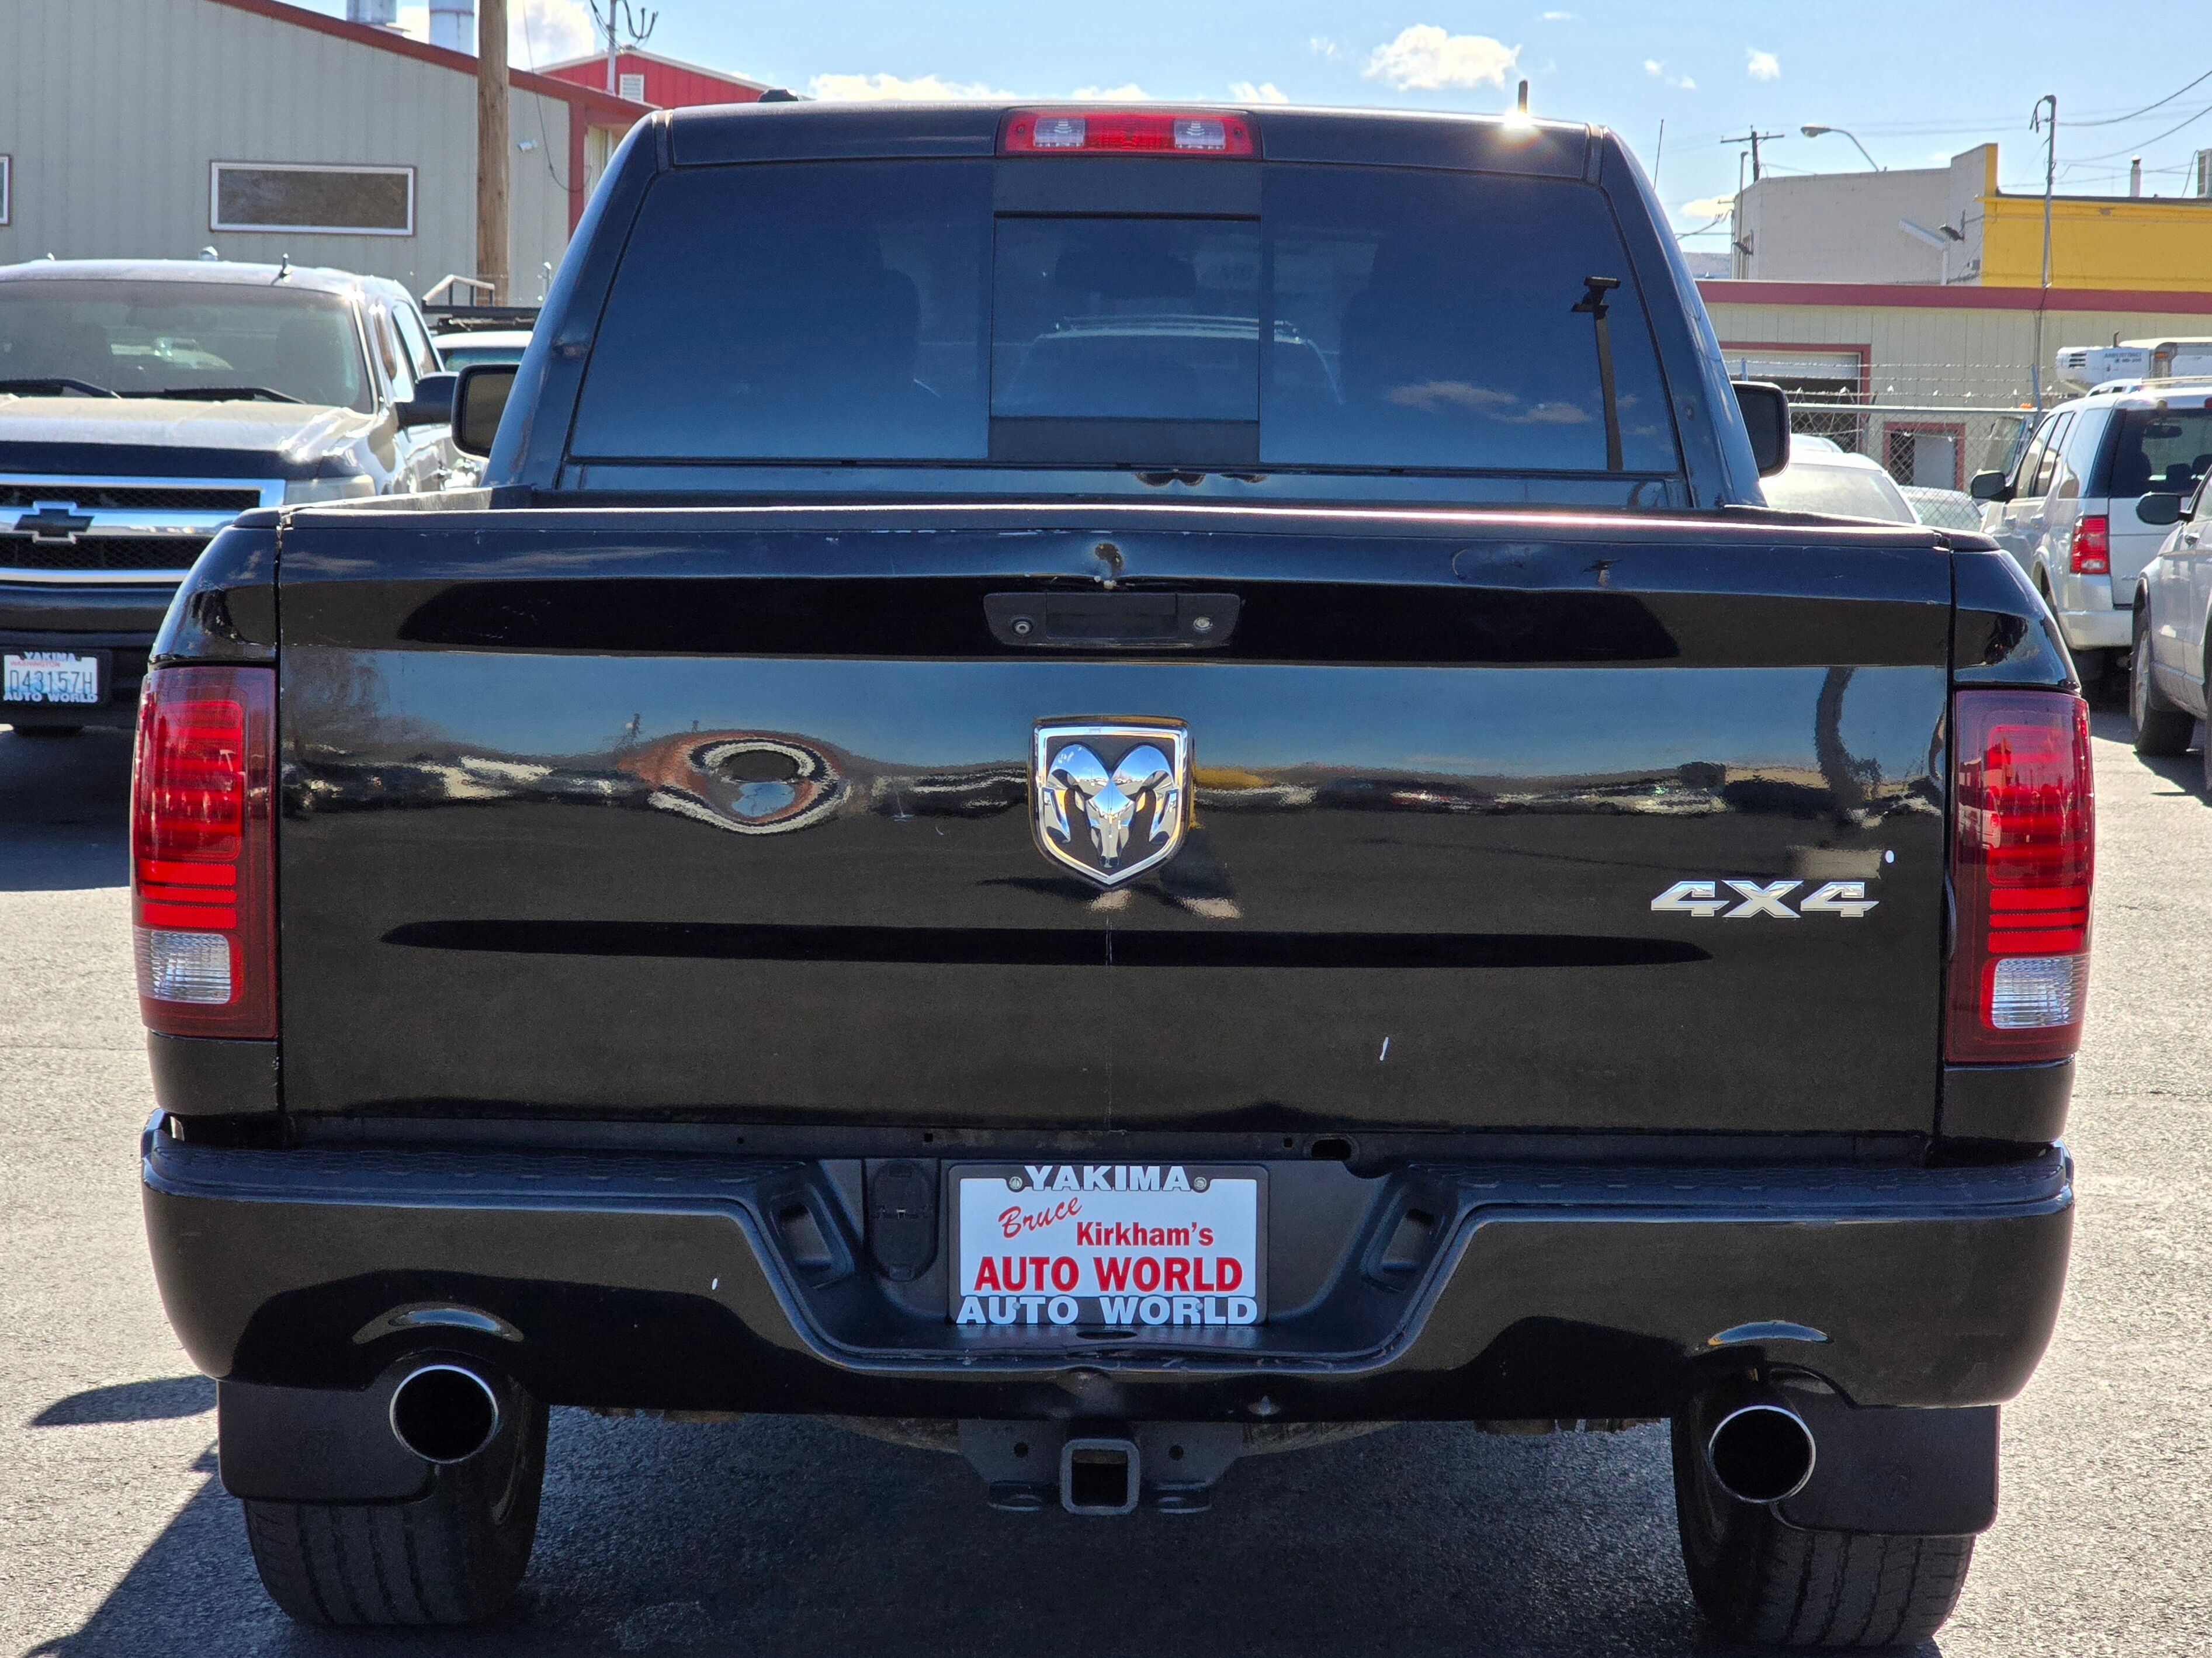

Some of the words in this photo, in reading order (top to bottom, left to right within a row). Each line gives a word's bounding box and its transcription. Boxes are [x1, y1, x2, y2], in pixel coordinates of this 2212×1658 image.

[24, 651, 76, 661] YAKIMA
[3, 692, 43, 702] AUTO
[47, 692, 98, 703] WORLD
[1024, 1165, 1191, 1191] YAKIMA
[998, 1197, 1083, 1239] Bruce
[1077, 1222, 1214, 1246] Kirkham's
[974, 1256, 1079, 1292] AUTO
[1094, 1257, 1243, 1292] WORLD
[956, 1296, 1079, 1324] AUTO
[1099, 1296, 1257, 1325] WORLD
